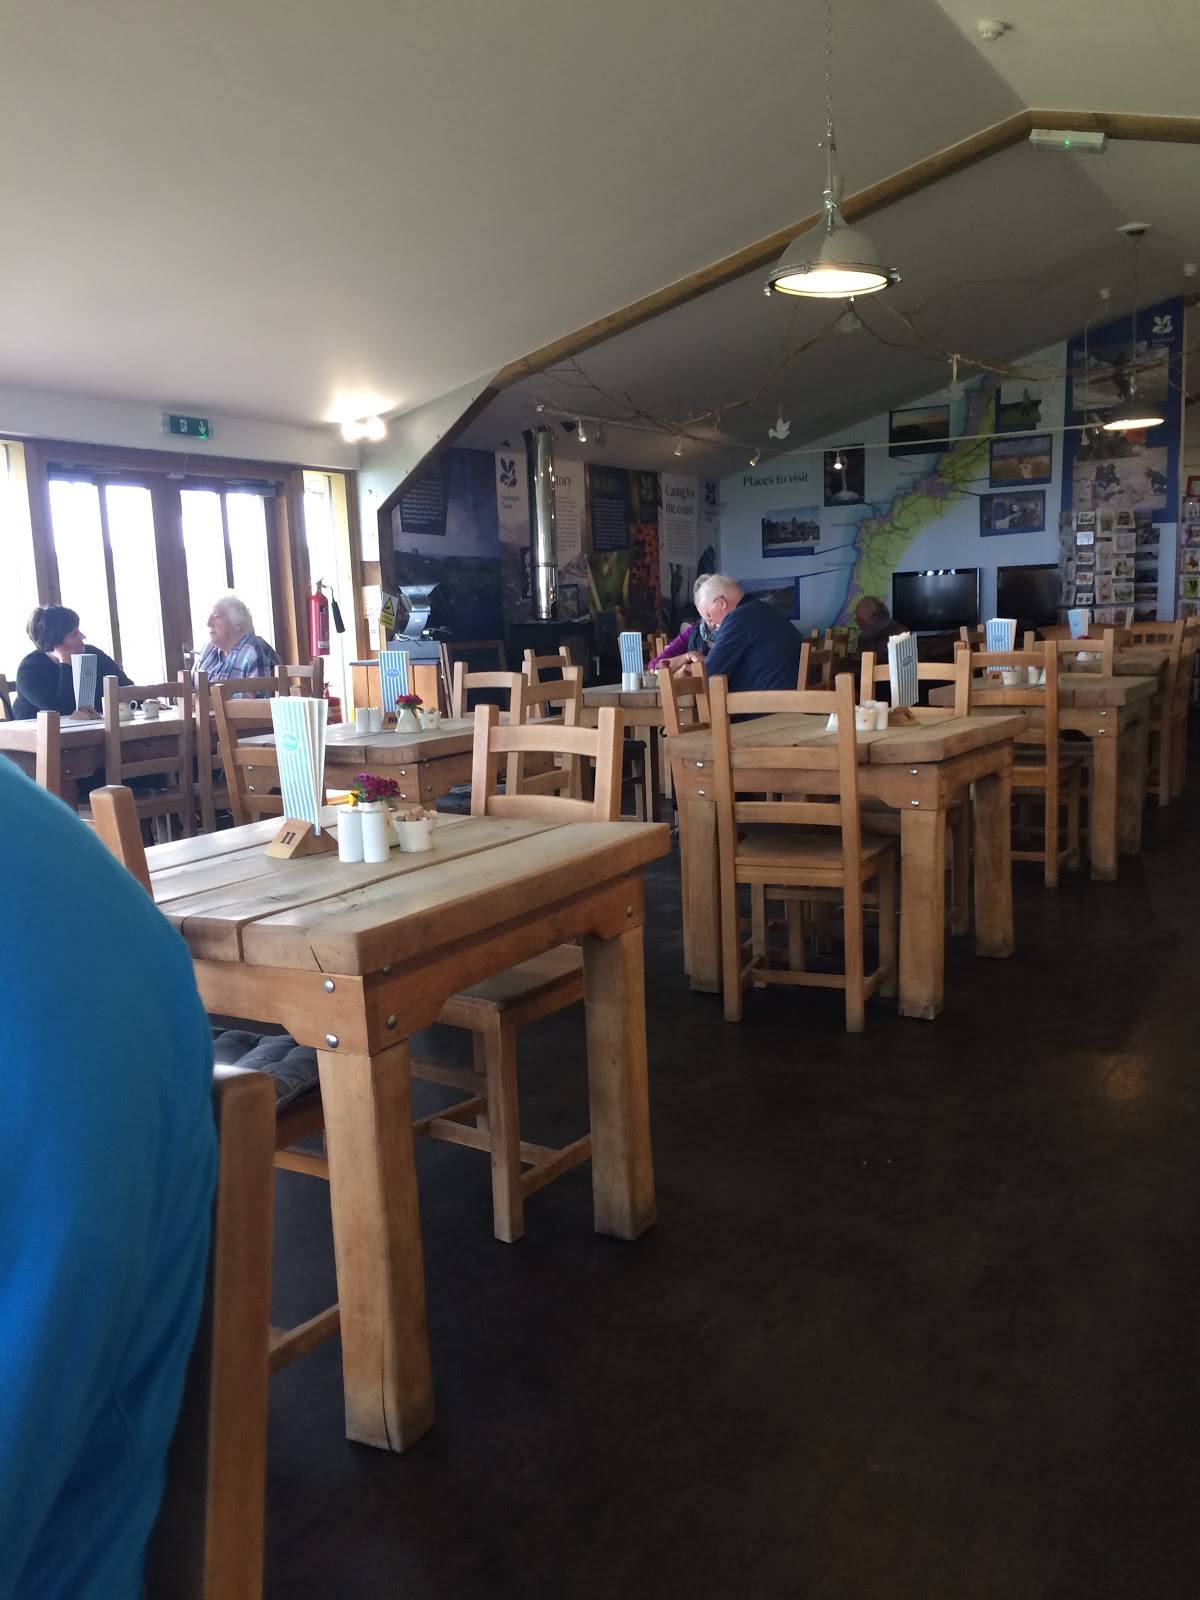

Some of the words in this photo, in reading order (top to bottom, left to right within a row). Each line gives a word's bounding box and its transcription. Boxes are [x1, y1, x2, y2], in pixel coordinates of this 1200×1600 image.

[743, 475, 773, 487] Places
[776, 475, 787, 484] to
[789, 472, 808, 483] visit
[665, 483, 687, 501] Caring
[665, 503, 676, 514] the
[280, 831, 296, 845] 11
